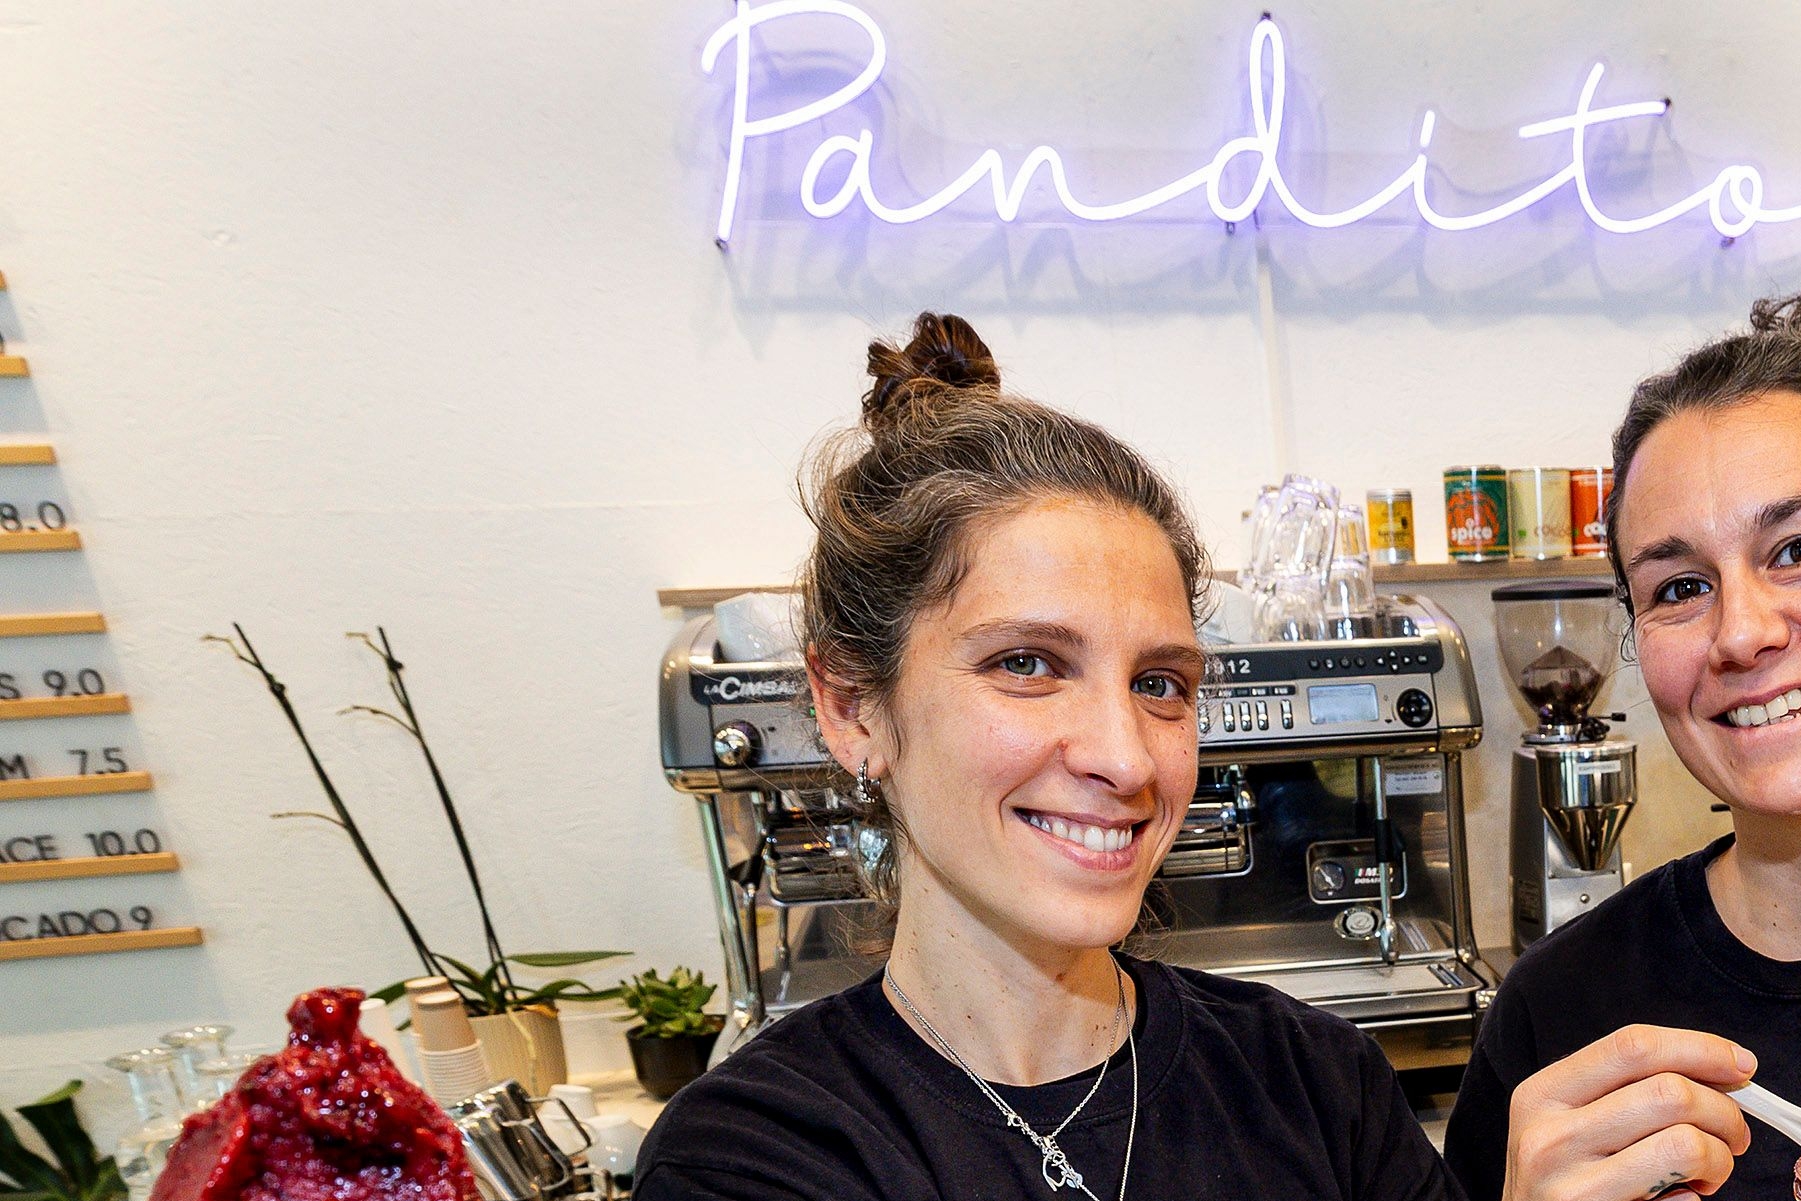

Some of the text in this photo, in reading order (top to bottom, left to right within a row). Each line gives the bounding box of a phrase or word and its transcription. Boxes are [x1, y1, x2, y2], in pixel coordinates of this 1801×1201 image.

[0, 502, 66, 531] 8.0
[42, 668, 105, 697] 9.0
[68, 747, 129, 775] 7.5
[0, 828, 161, 863] CE 10.0
[130, 905, 153, 931] 9
